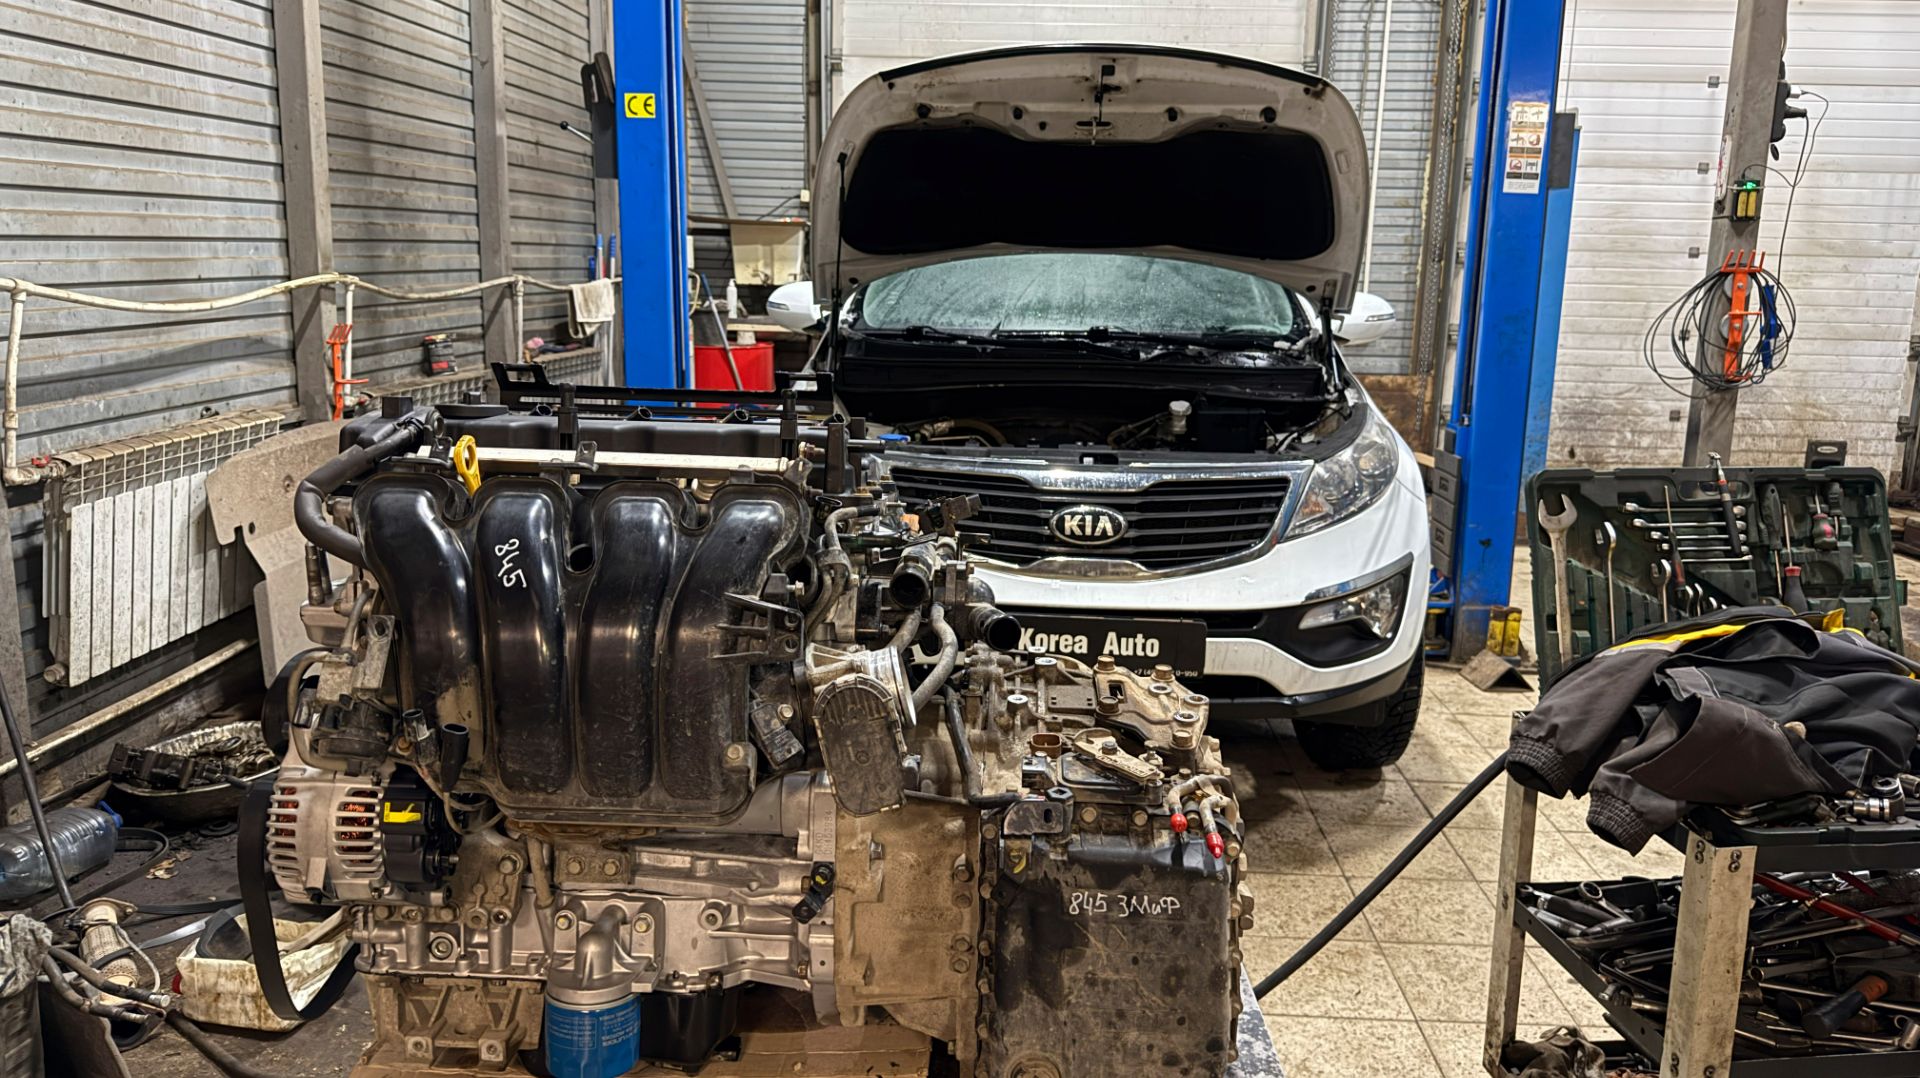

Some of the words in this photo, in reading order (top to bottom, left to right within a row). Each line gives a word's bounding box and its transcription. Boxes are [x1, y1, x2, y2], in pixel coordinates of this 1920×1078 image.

[627, 95, 654, 116] CE
[1063, 514, 1114, 537] KIA
[494, 538, 527, 588] 845
[1018, 627, 1088, 654] Korea
[1103, 631, 1160, 657] Auto
[1069, 891, 1108, 916] 845
